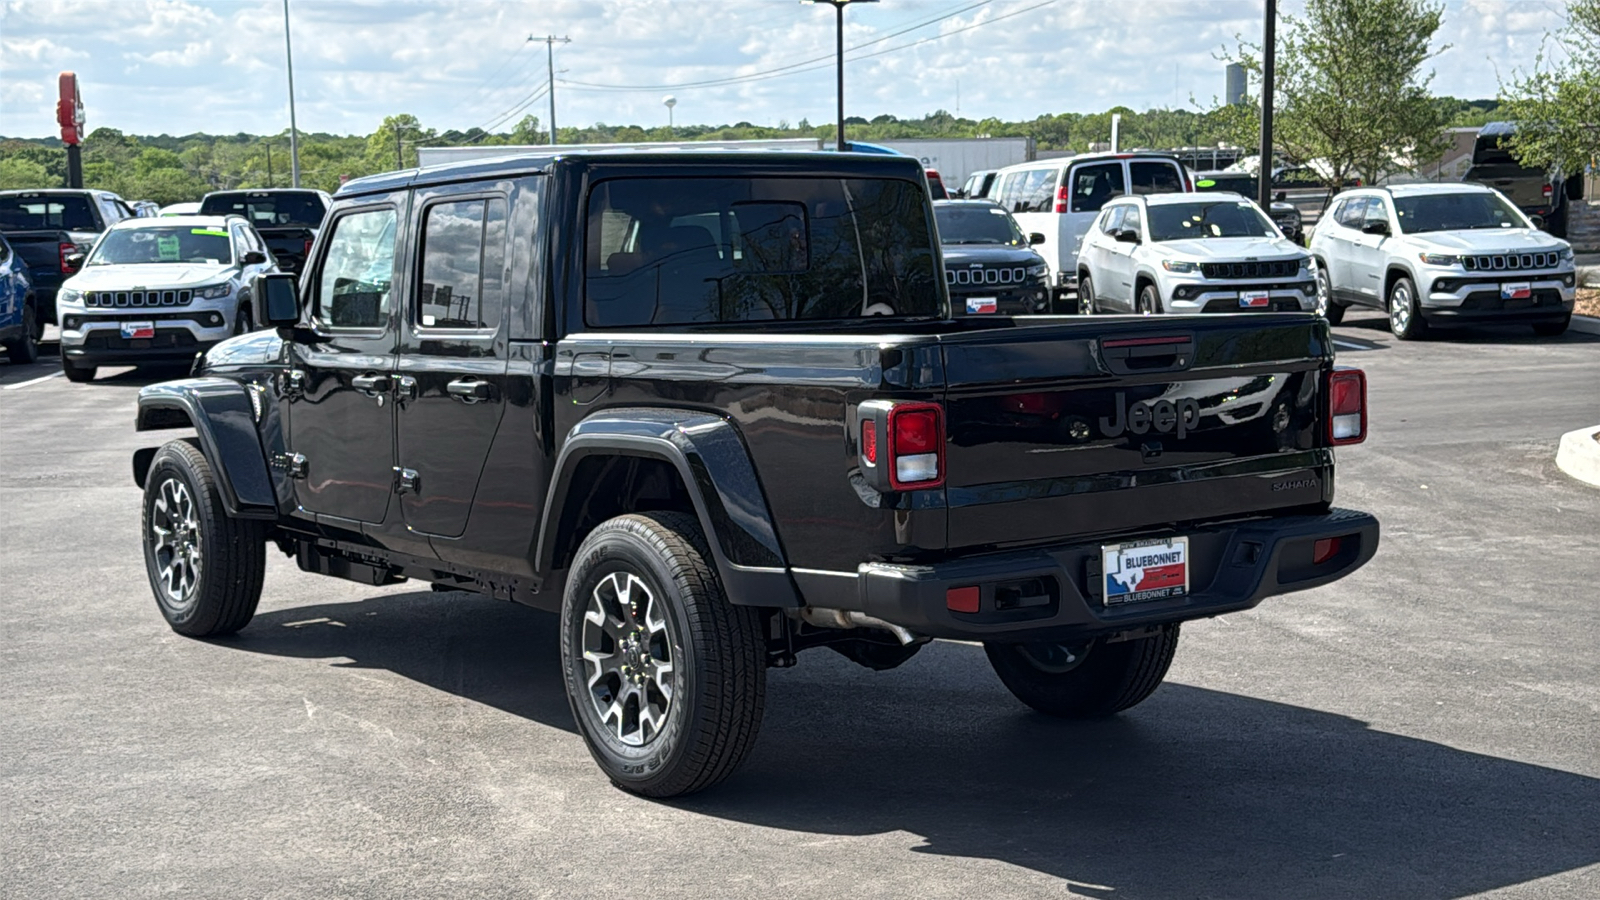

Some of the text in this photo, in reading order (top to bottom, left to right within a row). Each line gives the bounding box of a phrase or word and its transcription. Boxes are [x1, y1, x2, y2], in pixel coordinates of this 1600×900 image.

[1099, 391, 1200, 440] Jeep
[1271, 480, 1317, 492] SAHARA
[1125, 551, 1181, 569] BLUEBONNET
[1123, 588, 1170, 602] BLUEBONNET
